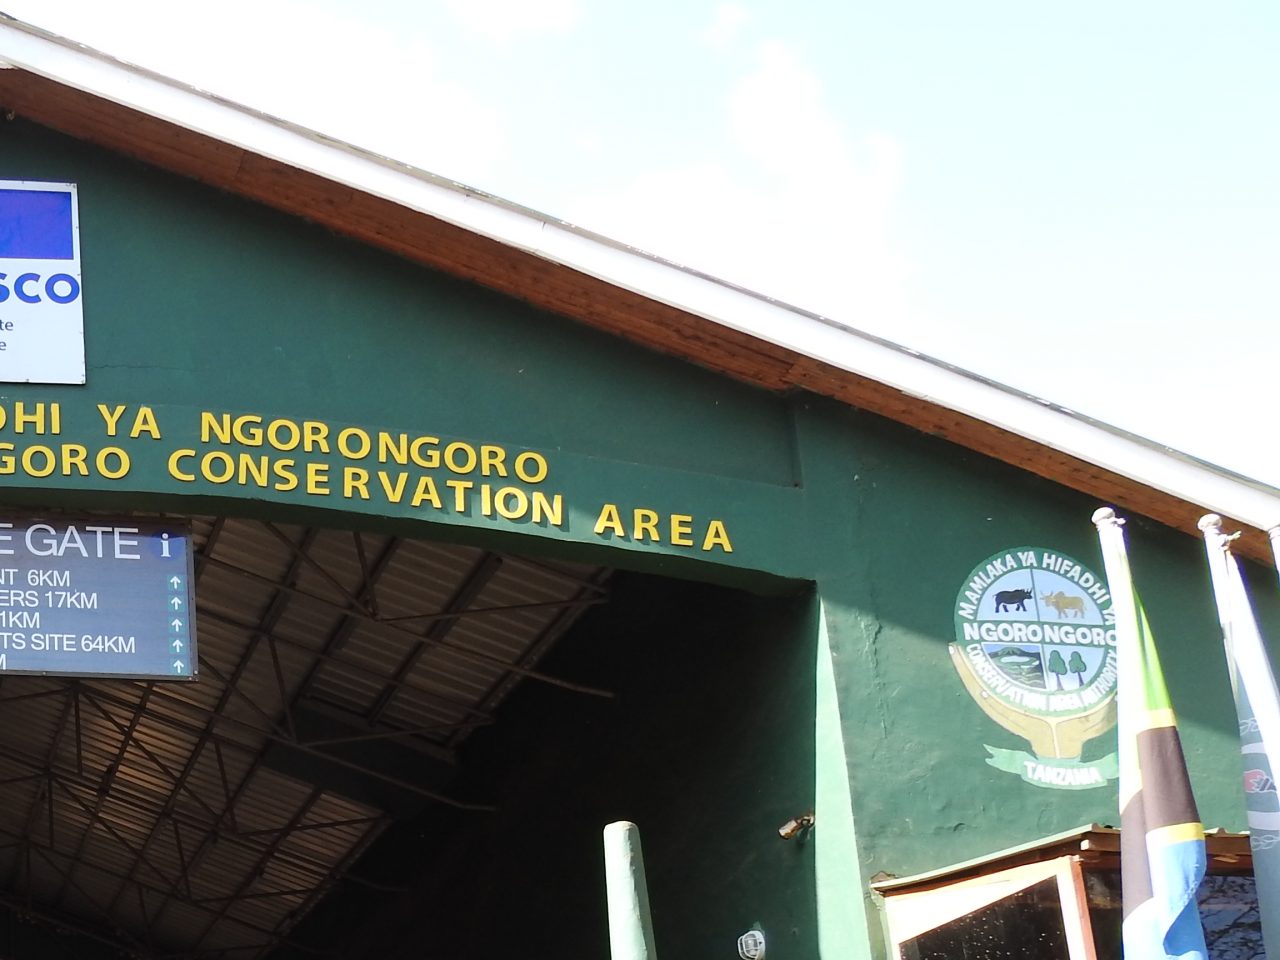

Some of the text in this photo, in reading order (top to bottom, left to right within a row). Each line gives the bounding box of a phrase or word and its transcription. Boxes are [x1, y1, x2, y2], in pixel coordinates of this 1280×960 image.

[97, 404, 161, 440] YA
[200, 411, 548, 485] NGORONGORO
[167, 449, 563, 527] CONSERVATION
[593, 503, 733, 553] AREA
[24, 523, 141, 560] GATE
[27, 570, 71, 588] 6KM
[958, 553, 1018, 620] MAMLAKA
[1017, 551, 1038, 567] YA
[1042, 552, 1110, 604] HIFADHI
[45, 591, 98, 609] 17KM
[31, 633, 77, 652] SITE
[81, 635, 136, 654] 64KM
